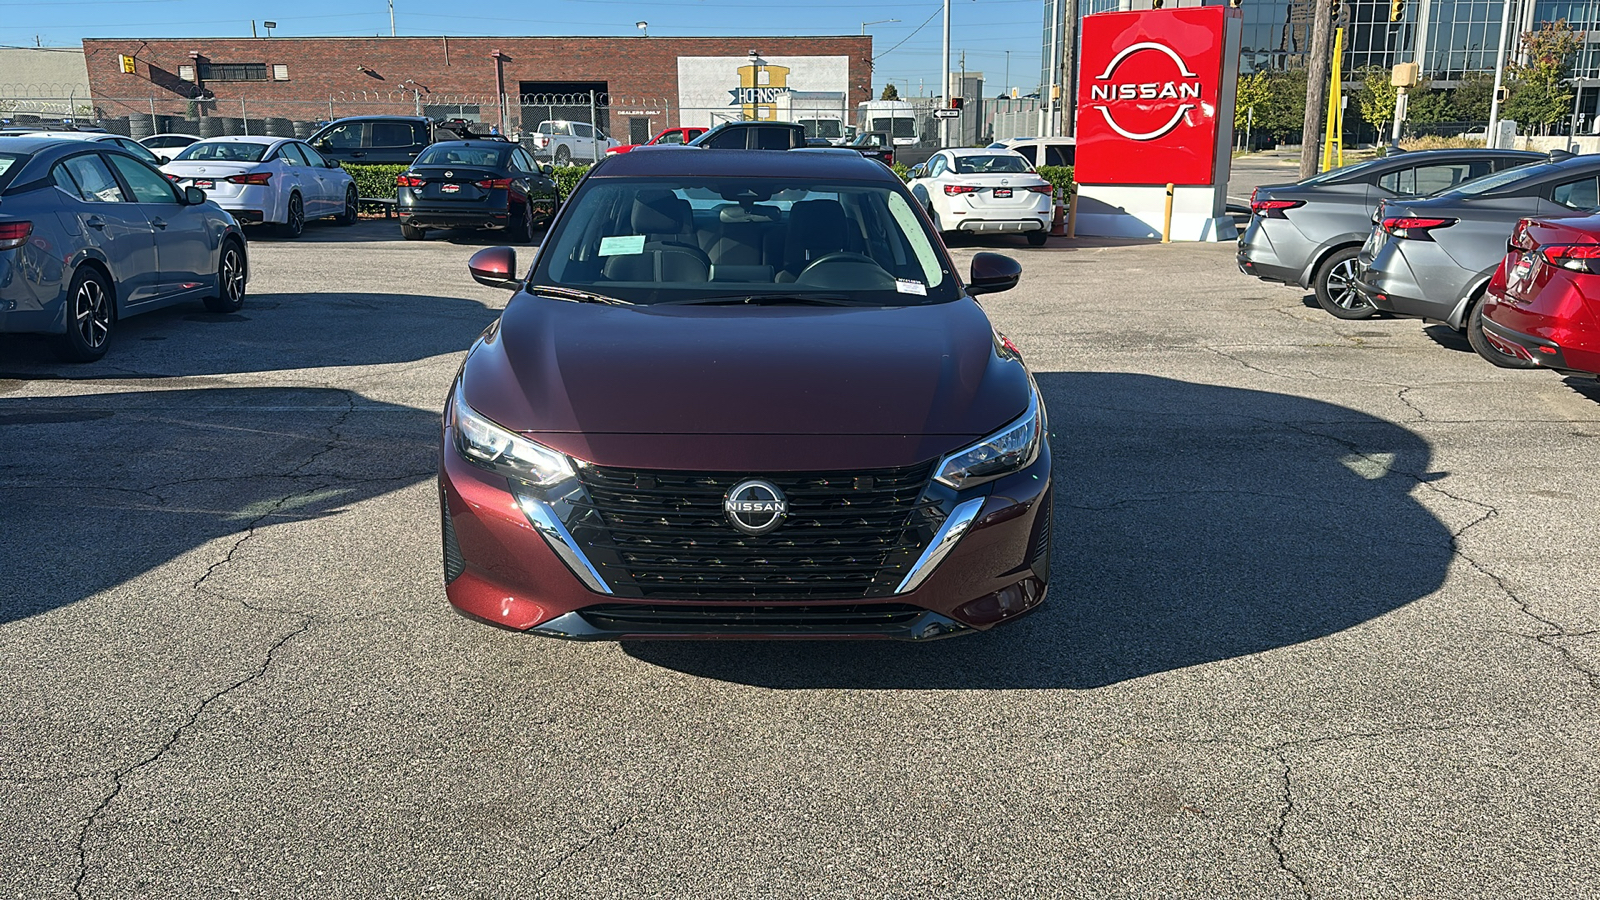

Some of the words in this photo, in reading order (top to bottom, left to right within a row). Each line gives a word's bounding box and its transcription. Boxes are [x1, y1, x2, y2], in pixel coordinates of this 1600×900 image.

[739, 88, 788, 103] HORNSB
[1091, 82, 1200, 100] NISSAN
[727, 502, 784, 511] NISSAN
